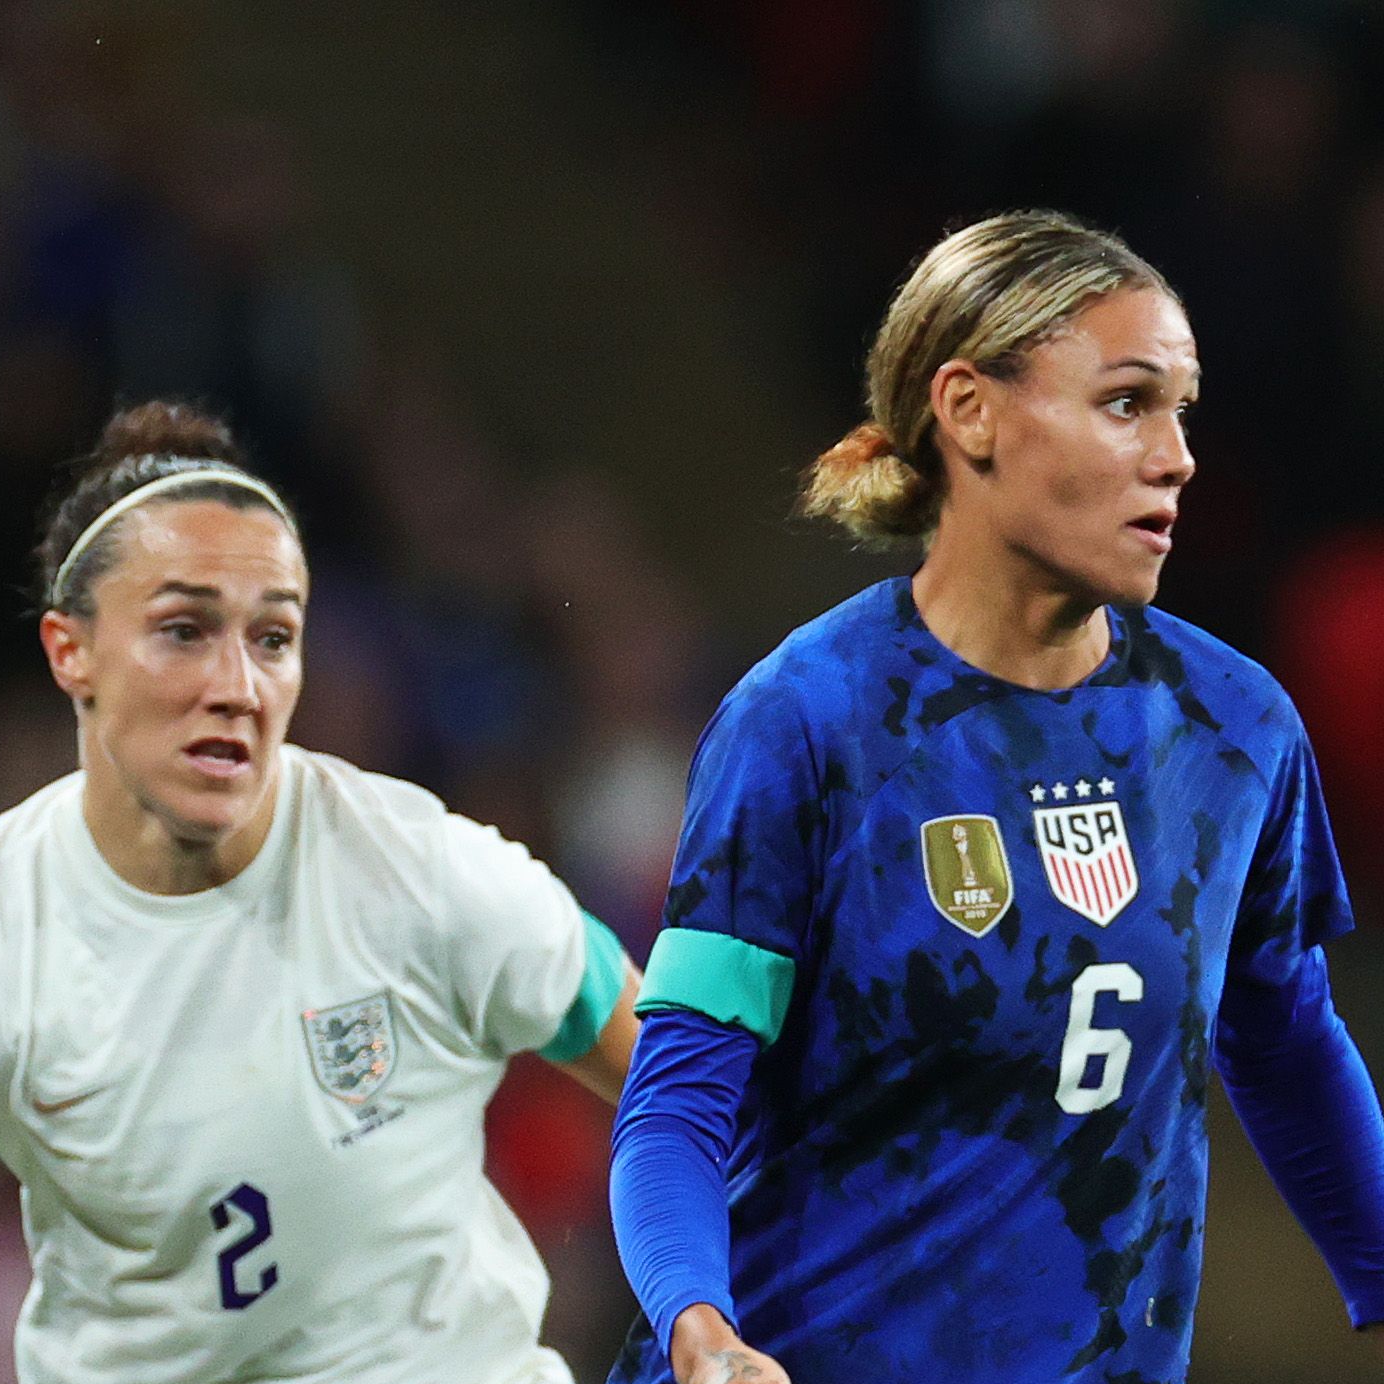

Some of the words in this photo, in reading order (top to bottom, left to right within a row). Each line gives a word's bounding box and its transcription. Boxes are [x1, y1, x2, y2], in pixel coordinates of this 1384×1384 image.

[1042, 810, 1117, 856] USA
[953, 888, 993, 905] FIFA
[1055, 963, 1144, 1115] 6
[209, 1182, 278, 1311] 2
